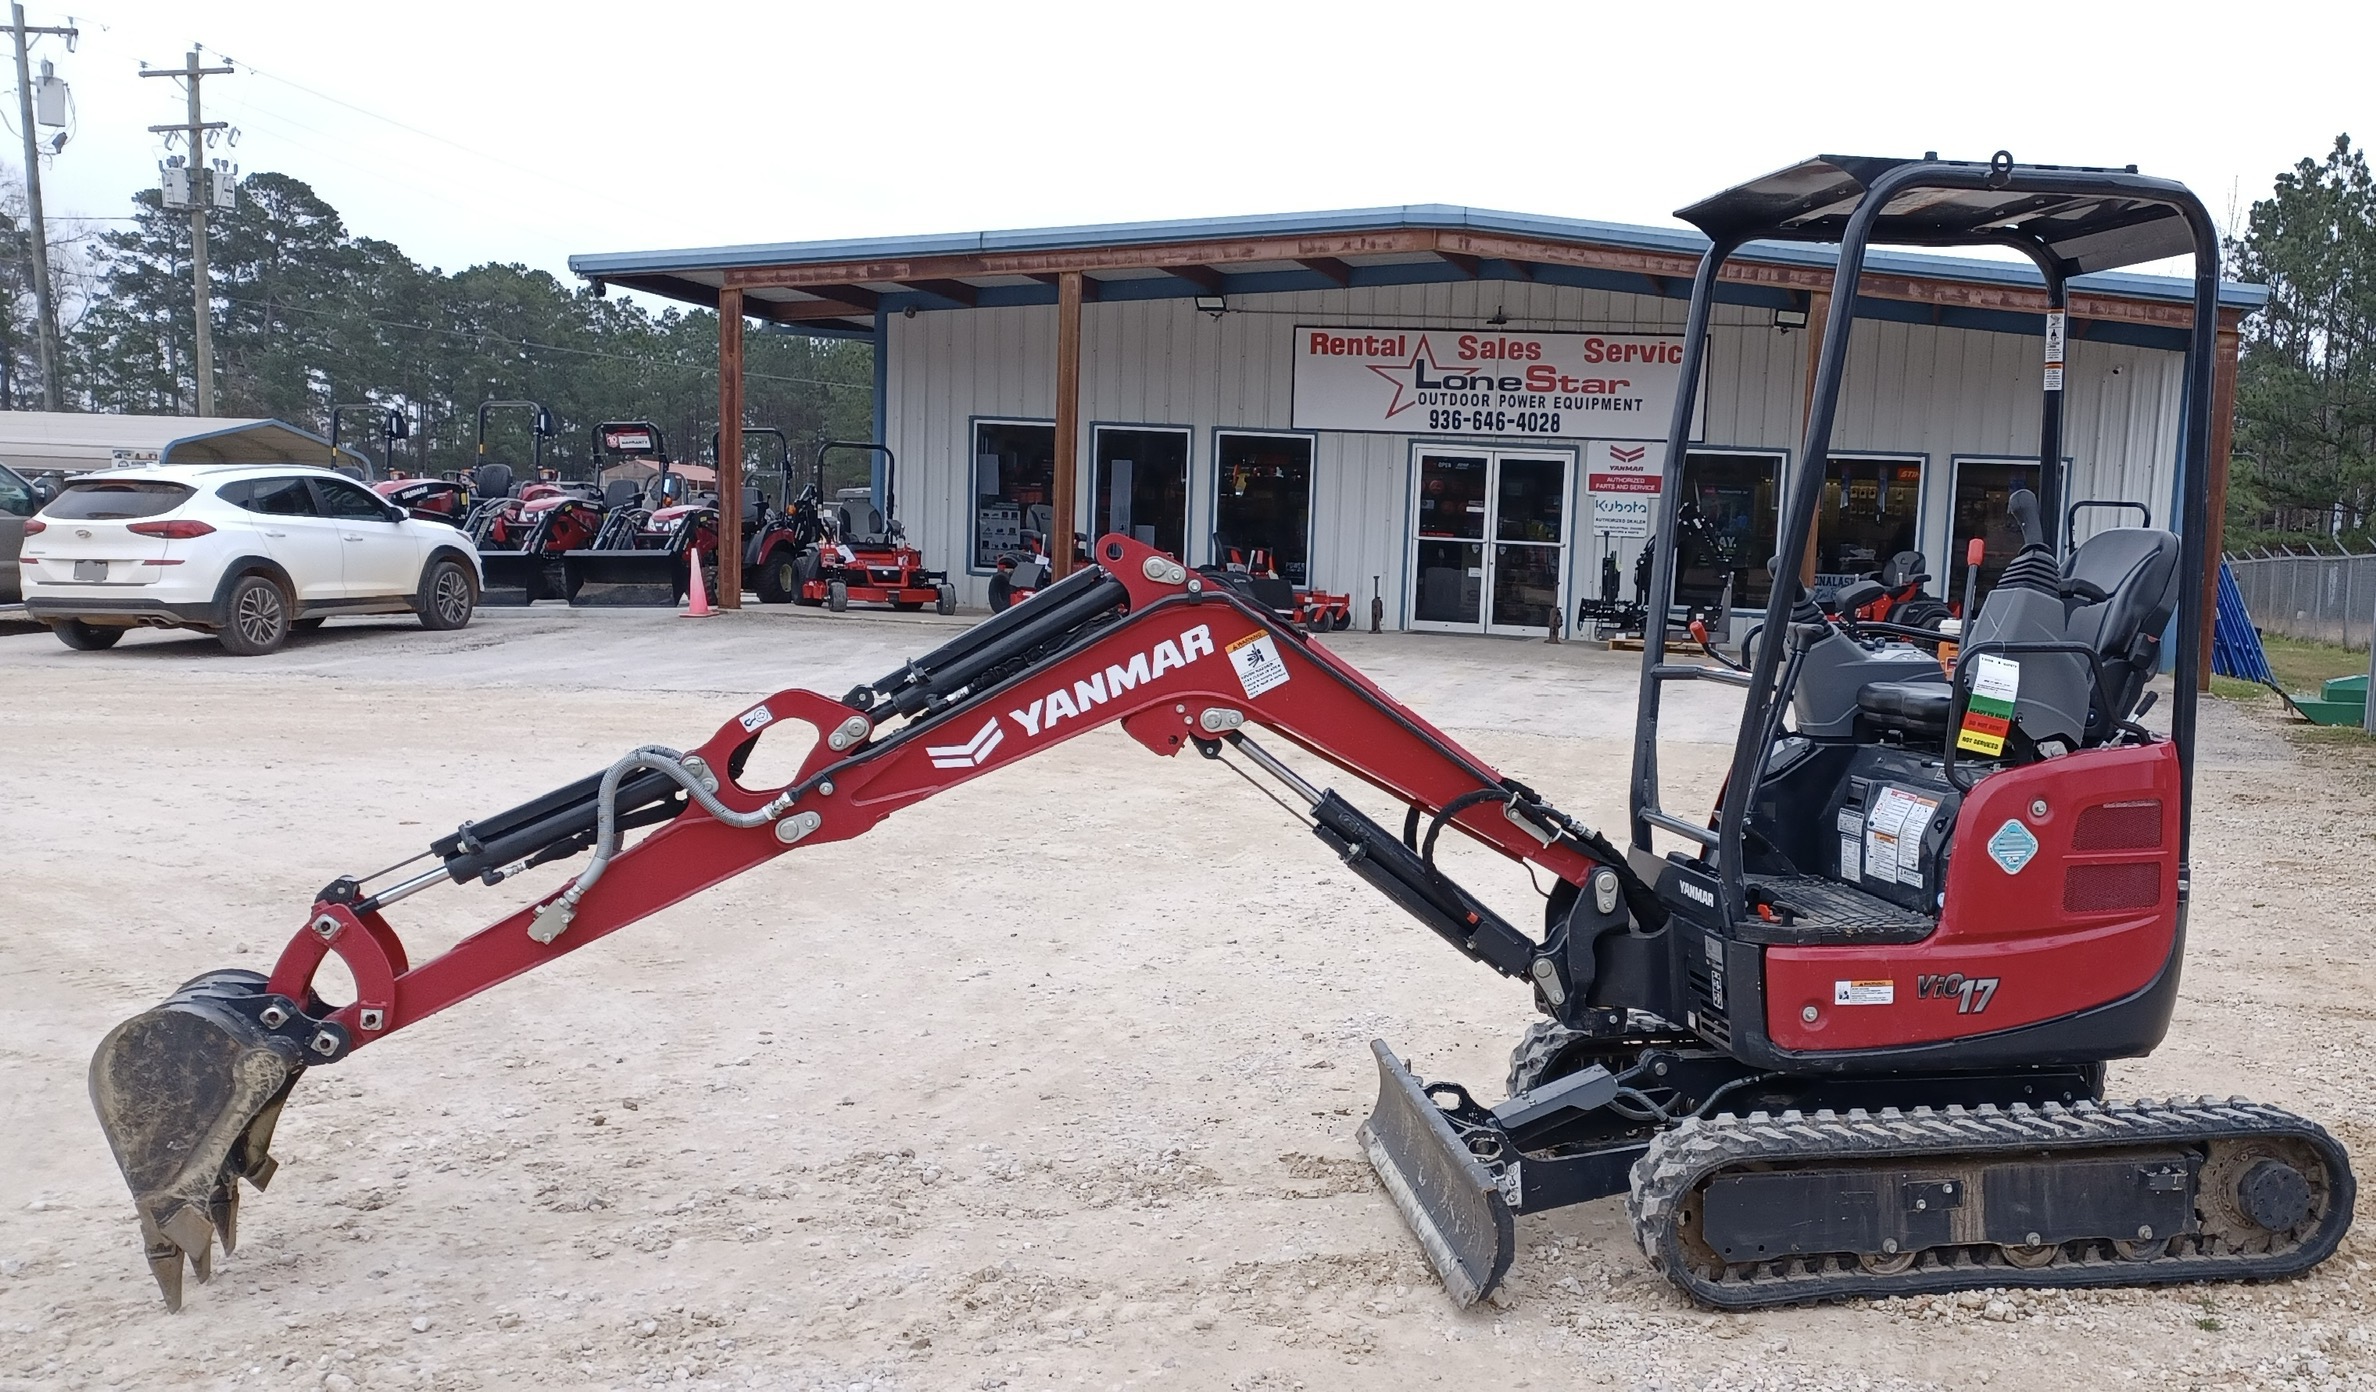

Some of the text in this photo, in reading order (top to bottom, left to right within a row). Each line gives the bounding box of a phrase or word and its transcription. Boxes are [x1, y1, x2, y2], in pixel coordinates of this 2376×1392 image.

[1310, 332, 1683, 365] Rental Sales Servic
[1415, 359, 1631, 394] LoneStar
[1417, 391, 1643, 411] OUTDOOR POWER EQUIPMENT
[1429, 409, 1561, 433] 936-646-4028
[1595, 500, 1647, 513] Kubota
[1008, 624, 1214, 737] YANMAR
[1679, 879, 1714, 908] YANMAR
